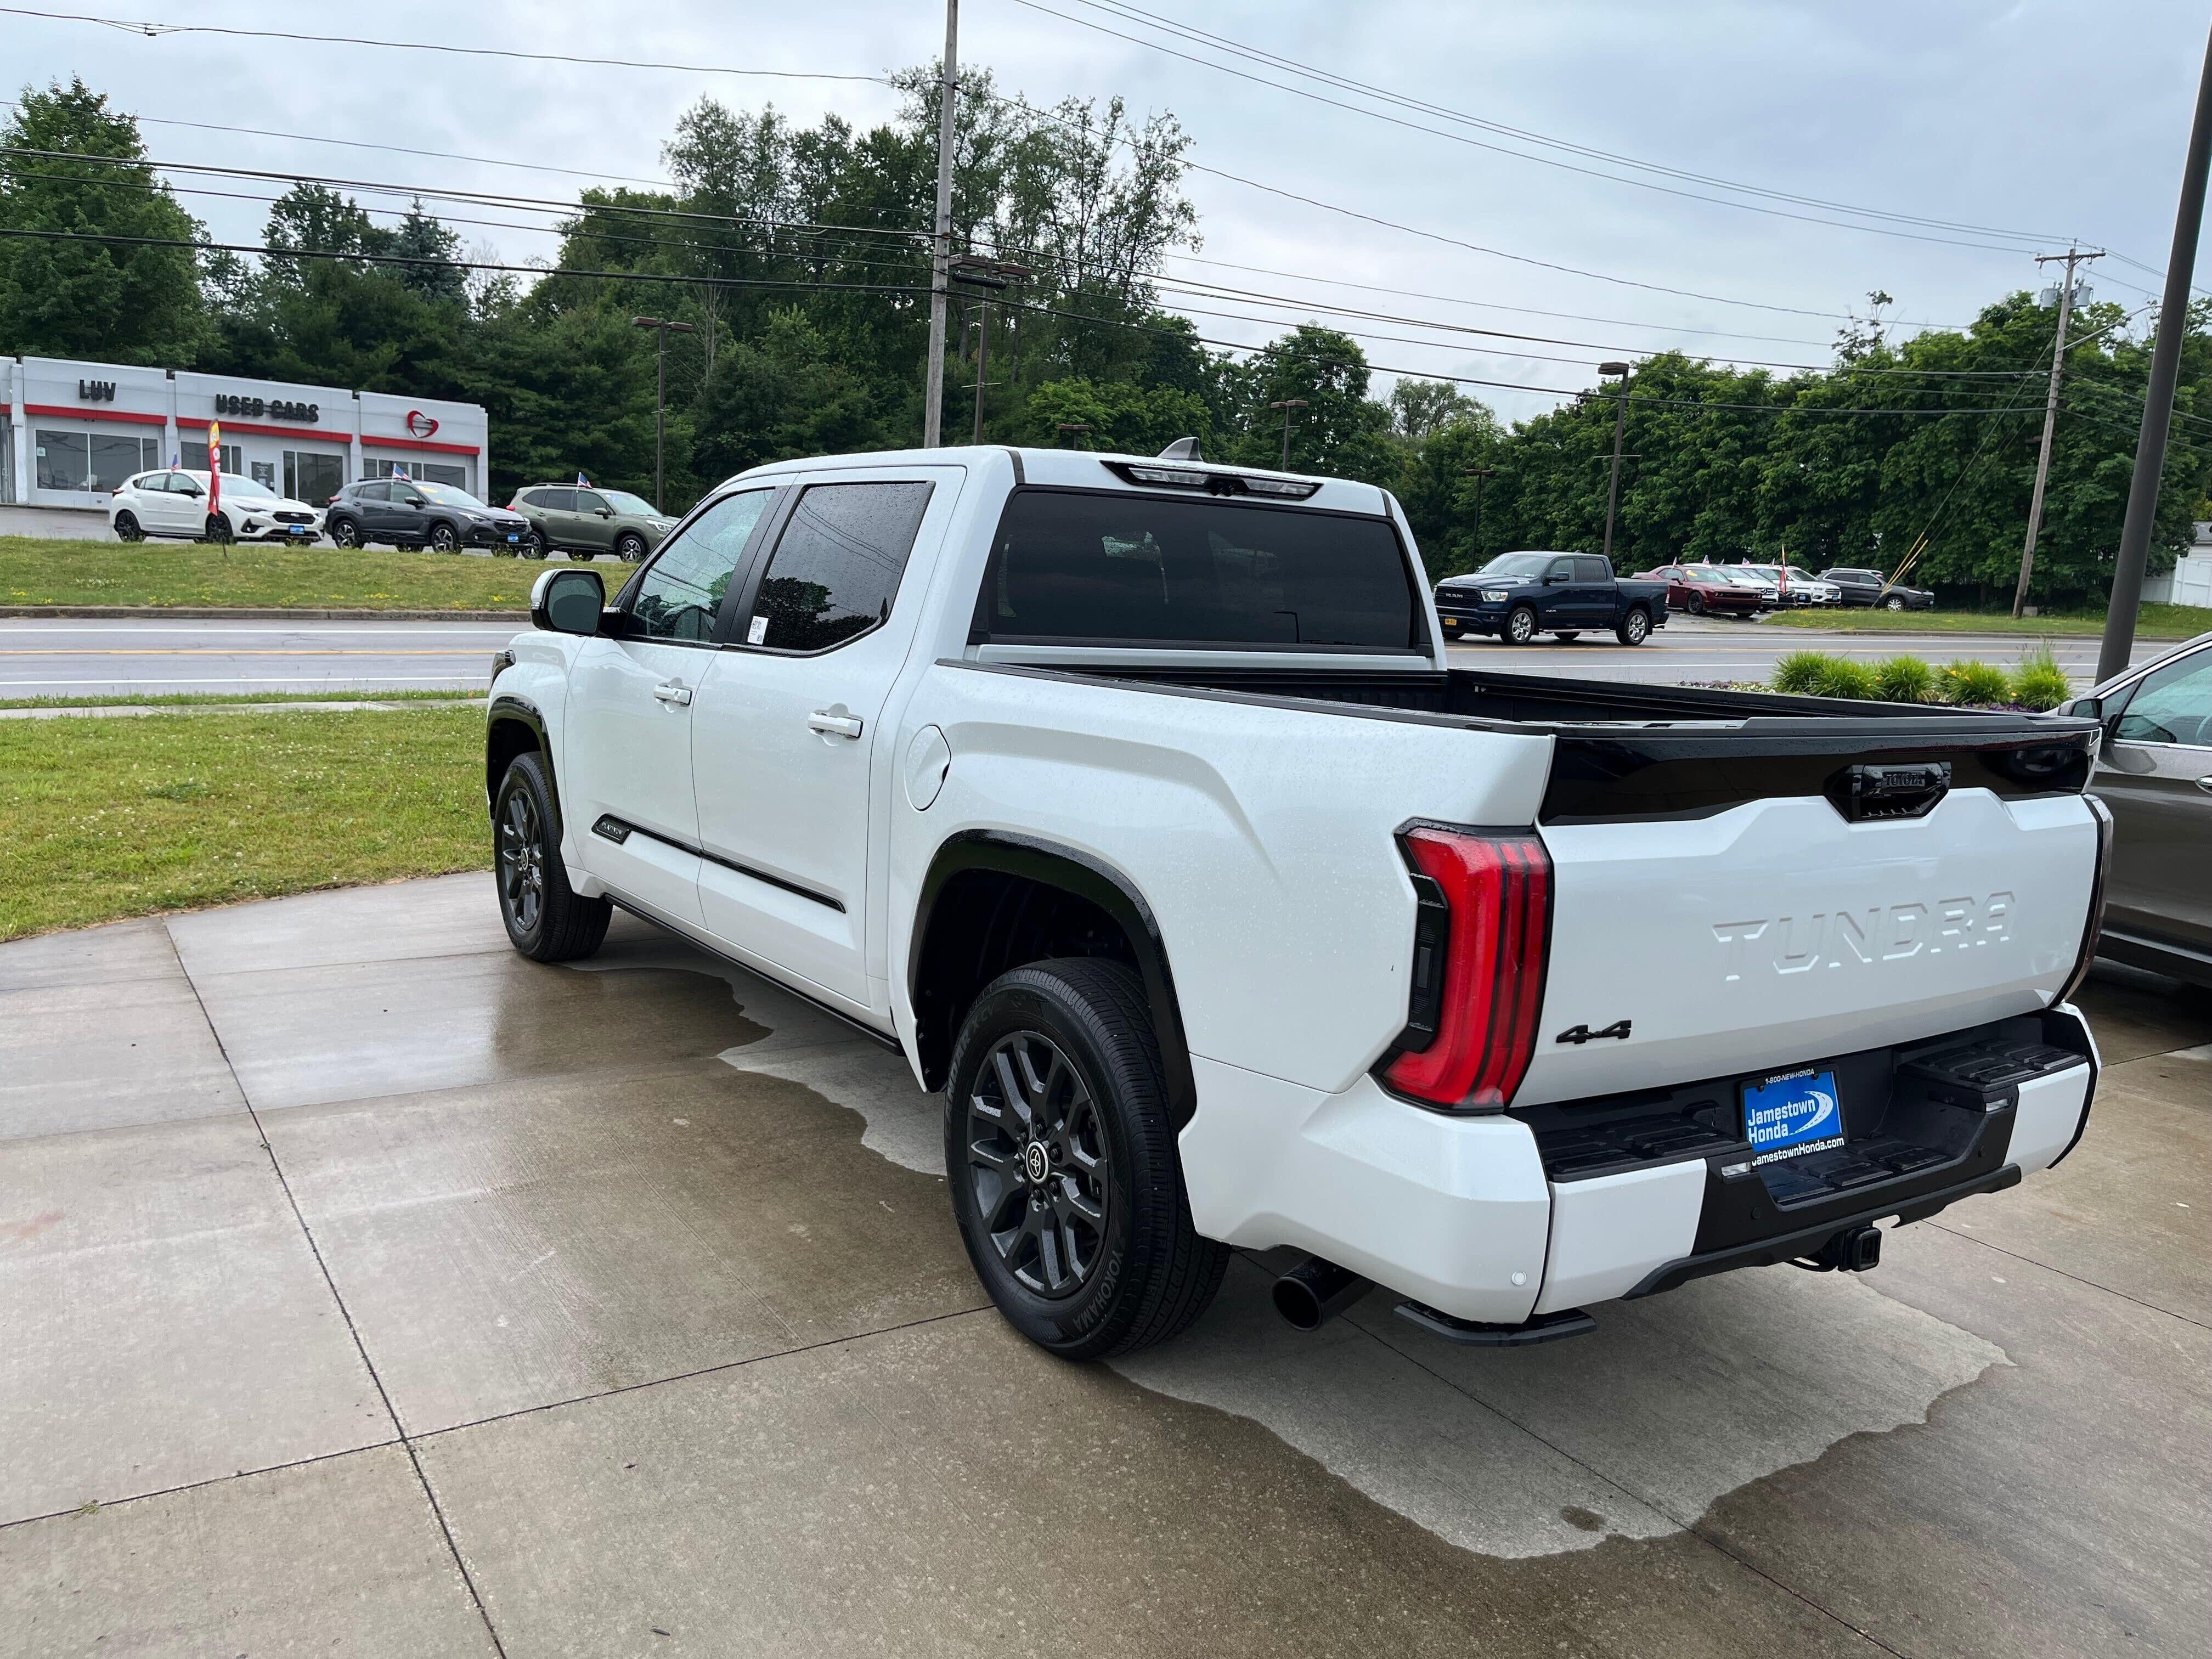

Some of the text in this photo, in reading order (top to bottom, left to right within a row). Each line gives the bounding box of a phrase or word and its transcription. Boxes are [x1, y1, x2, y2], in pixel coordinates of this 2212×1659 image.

[80, 379, 116, 401] LUV
[216, 394, 319, 422] USED CARS
[1886, 771, 1922, 786] TOYOTA
[1711, 890, 2016, 981] TUNDRA
[1765, 1068, 1815, 1085] 1-800-NEW-HONDA
[1748, 1098, 1816, 1126] Jamestown
[1748, 1122, 1788, 1144] Honda
[1073, 1250, 1124, 1333] YOKOHAMA
